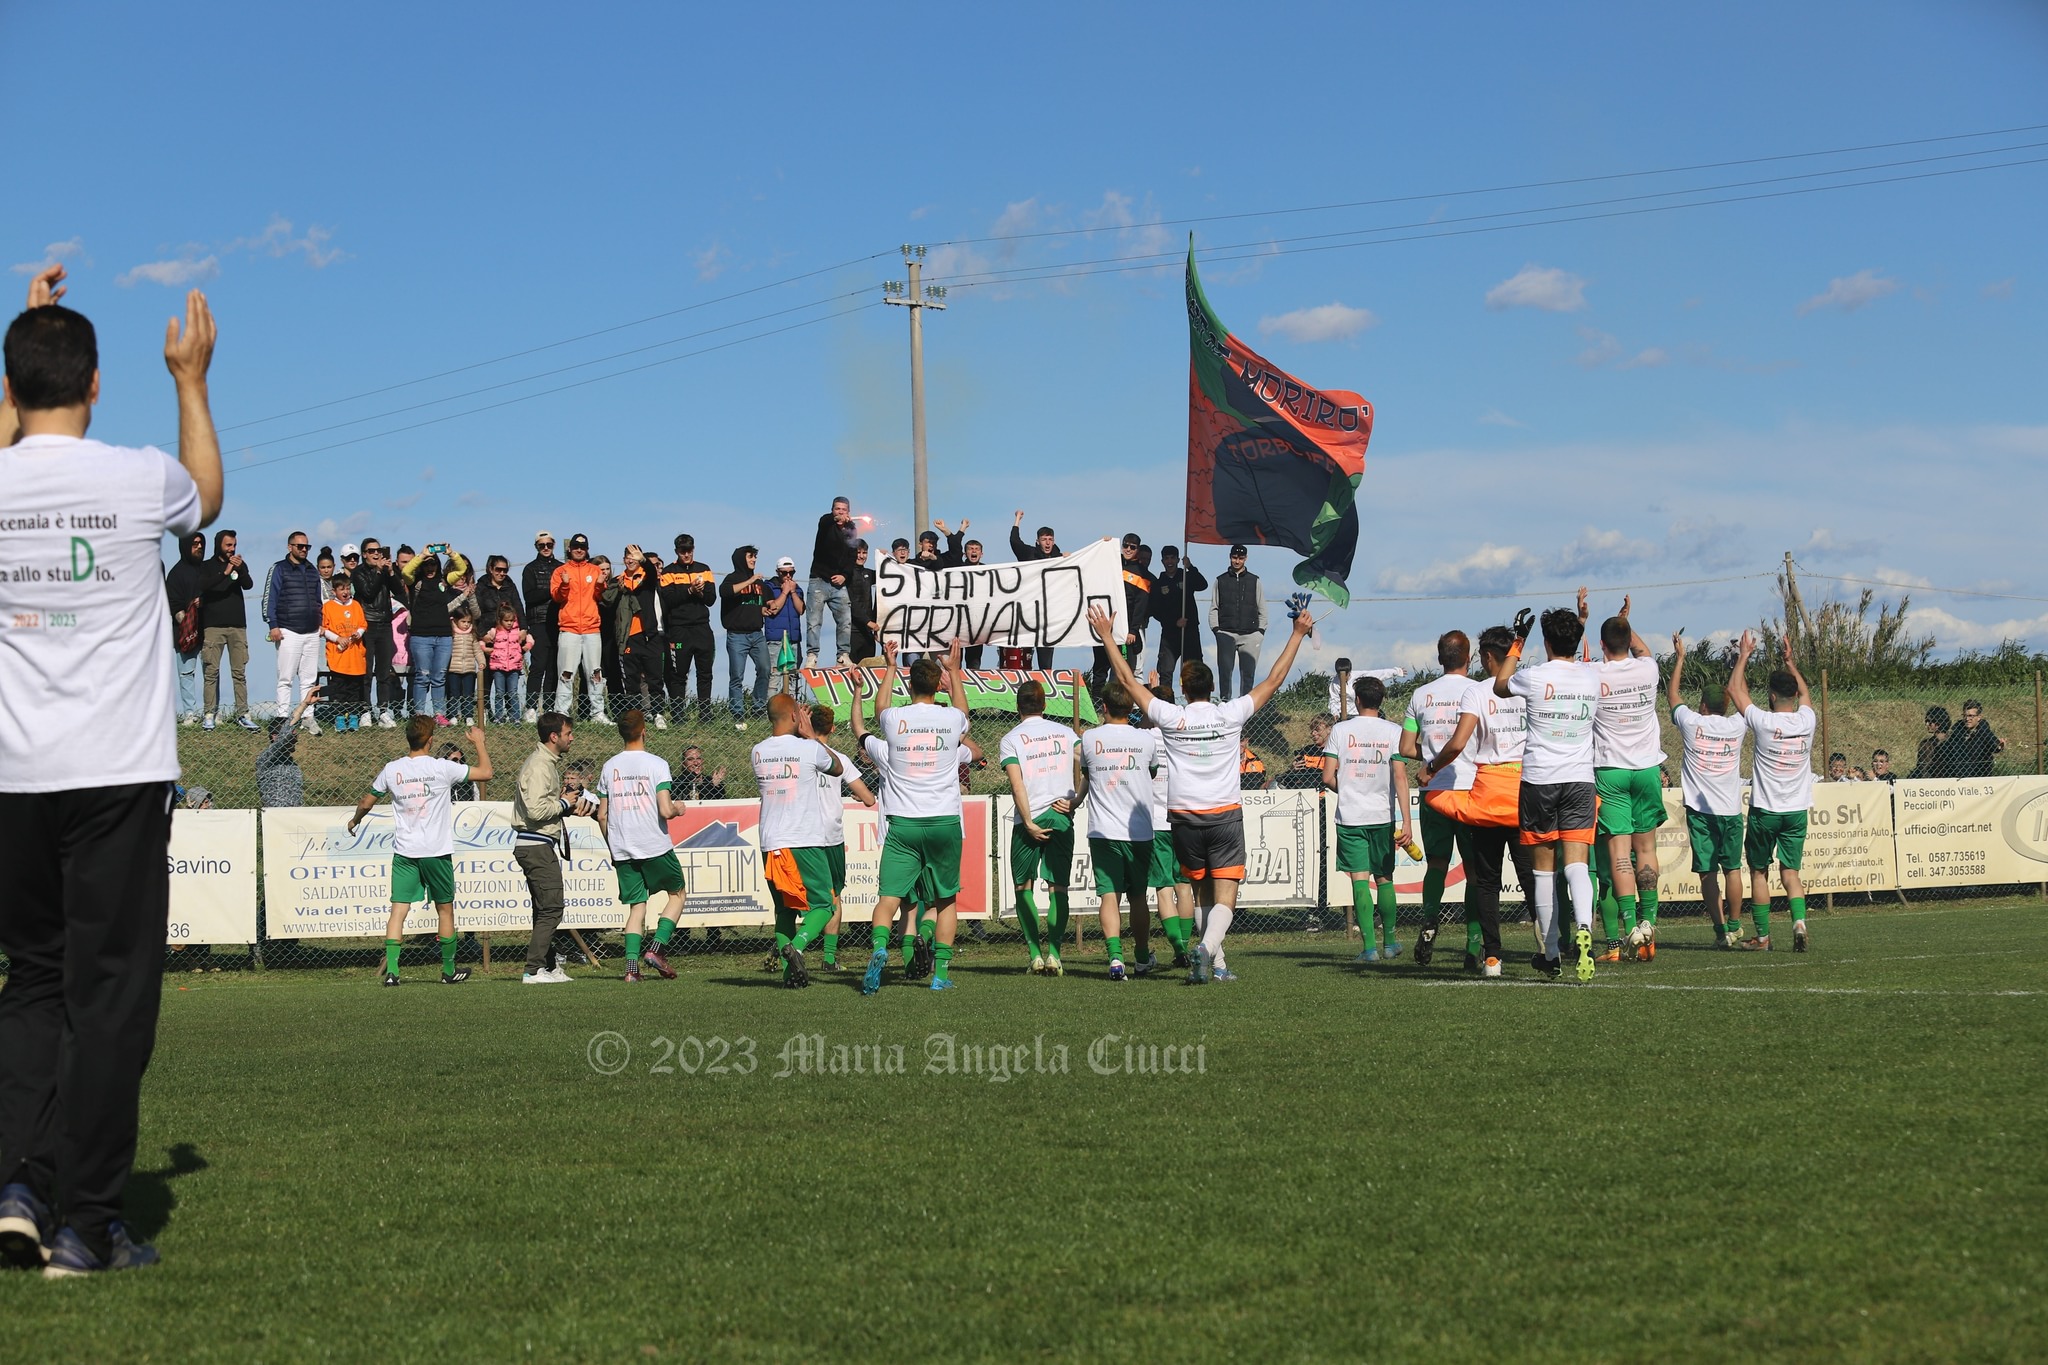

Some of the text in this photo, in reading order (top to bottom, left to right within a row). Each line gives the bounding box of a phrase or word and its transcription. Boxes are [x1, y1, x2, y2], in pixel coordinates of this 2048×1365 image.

[56, 512, 64, 529] è
[71, 513, 117, 530] tutto!
[13, 566, 41, 582] allo
[879, 557, 1022, 600] STIAMO
[49, 613, 76, 627] 2023
[1544, 683, 1555, 701] Da
[898, 719, 908, 735] Da
[1241, 793, 1276, 805] ssai
[1903, 786, 1994, 798] Via Secondo Viale, 33
[1903, 800, 1955, 811] Peccioli (PI)
[1836, 803, 1864, 824] Srl
[1805, 826, 1890, 841] oncessionaria Auto
[1904, 822, 1993, 837] ufficio@incart.net
[1801, 849, 1812, 857] ax
[1814, 847, 1830, 857] 050
[1906, 850, 1986, 864] Tel. 0587.735619
[290, 858, 613, 881] OFFICI MECCNICA
[845, 860, 871, 871] rona,
[1813, 858, 1884, 869] www.nestiauto.it
[1907, 865, 1986, 878] cell. 347.3053588
[850, 874, 874, 885] 0586
[1661, 884, 1675, 895] A.
[1801, 874, 1864, 890] spedaletto
[302, 878, 606, 901] SALDATURE RUZIONI MNICHE
[295, 907, 319, 916] Via
[325, 905, 348, 915] del
[454, 900, 518, 910] IVORNO
[166, 922, 190, 938] 36
